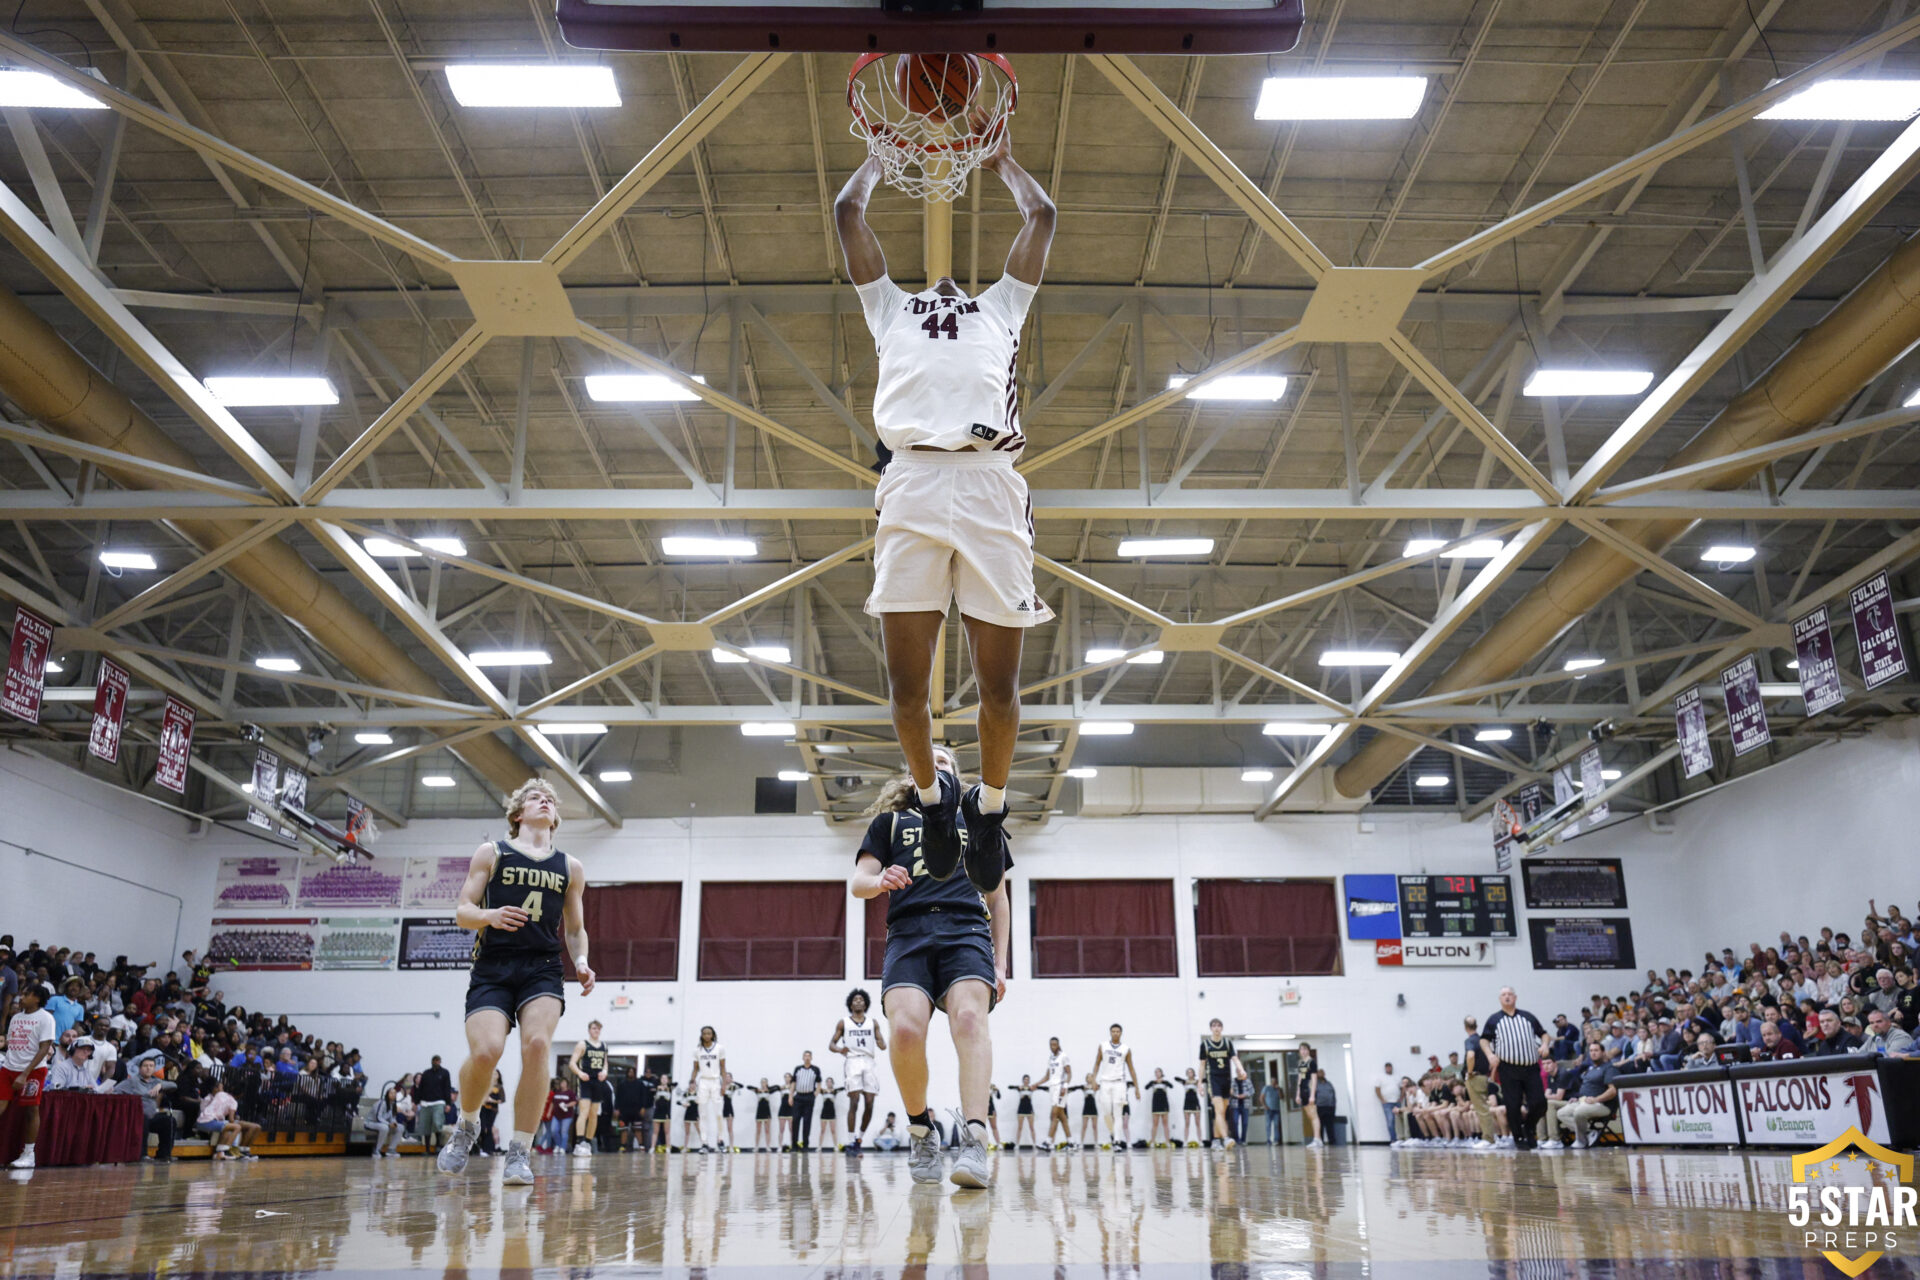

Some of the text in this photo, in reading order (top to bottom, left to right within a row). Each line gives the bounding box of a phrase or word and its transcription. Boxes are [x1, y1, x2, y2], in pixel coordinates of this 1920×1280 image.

[921, 312, 958, 340] 44
[1852, 574, 1886, 605] FULTON
[16, 612, 51, 639] FULTON
[1794, 608, 1826, 636] FULTON
[1862, 626, 1895, 652] FALCONS
[103, 661, 128, 684] FULTON
[1723, 658, 1752, 683] FULTON
[1803, 657, 1834, 681] FALCONS
[1867, 660, 1904, 686] TOURNAMENT
[1874, 654, 1893, 671] STATE
[8, 667, 43, 690] FALCONS
[10, 691, 30, 705] STATE
[1676, 688, 1699, 709] FULTON
[1807, 690, 1840, 713] TOURNAMENT
[1814, 684, 1831, 699] STATE
[166, 700, 194, 721] FULTON
[1732, 701, 1761, 724] FALCONS
[1736, 730, 1768, 753] TOURNAMENT
[1742, 726, 1758, 740] STATE
[502, 866, 565, 894] STONE
[1408, 886, 1427, 902] 22
[521, 890, 543, 922] 4
[1405, 946, 1470, 957] FULTON
[856, 1038, 866, 1047] 14
[591, 1058, 603, 1069] 22
[1217, 1058, 1225, 1069] 3
[1650, 1075, 1831, 1134] FULTON FALCONS
[1680, 1119, 1713, 1132] Tennova
[1776, 1117, 1815, 1131] Tennova
